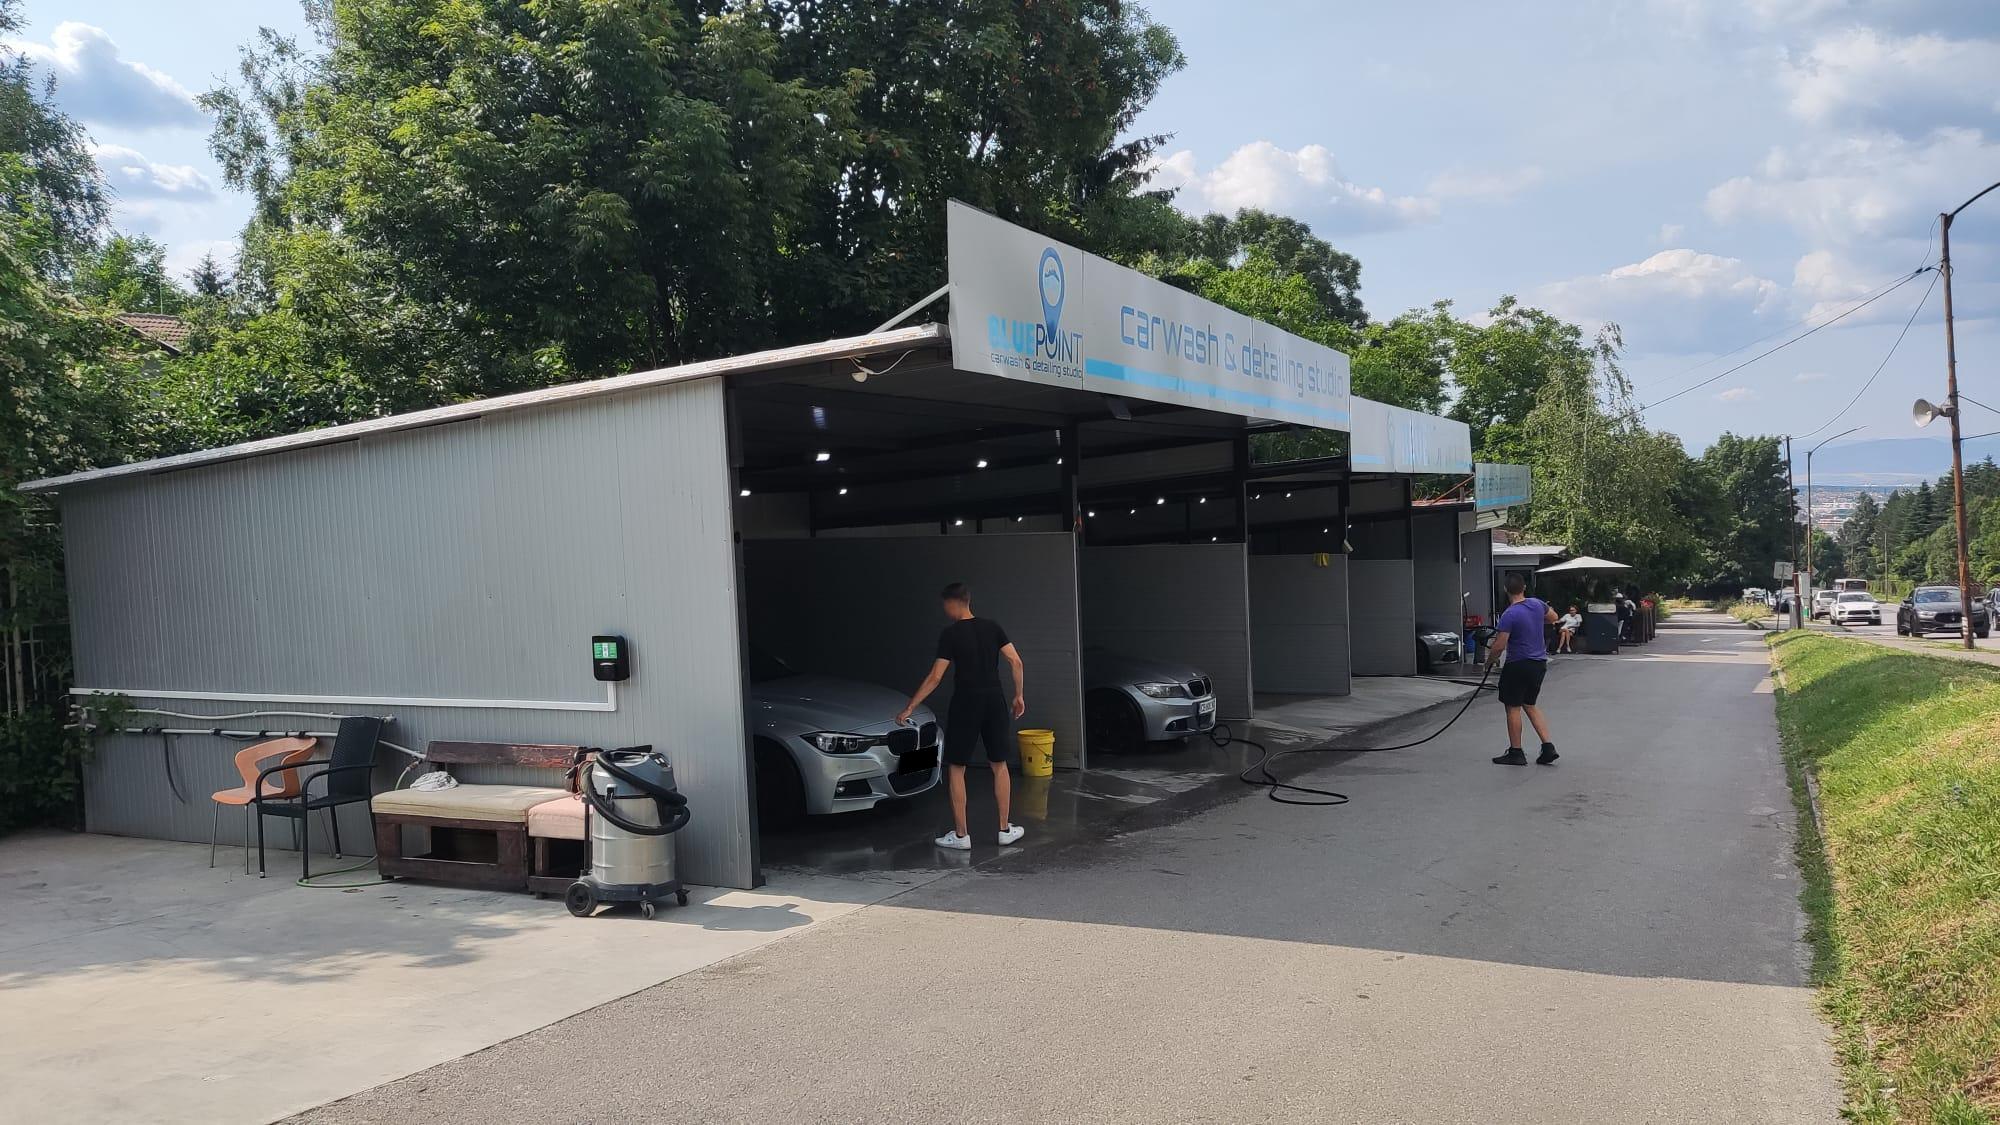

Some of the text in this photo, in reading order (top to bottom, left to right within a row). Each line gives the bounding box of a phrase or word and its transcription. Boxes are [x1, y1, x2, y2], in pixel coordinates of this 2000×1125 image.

[991, 352, 1024, 369] carwash
[1033, 359, 1061, 377] detailing
[1121, 305, 1344, 398] carwash & detailing studio
